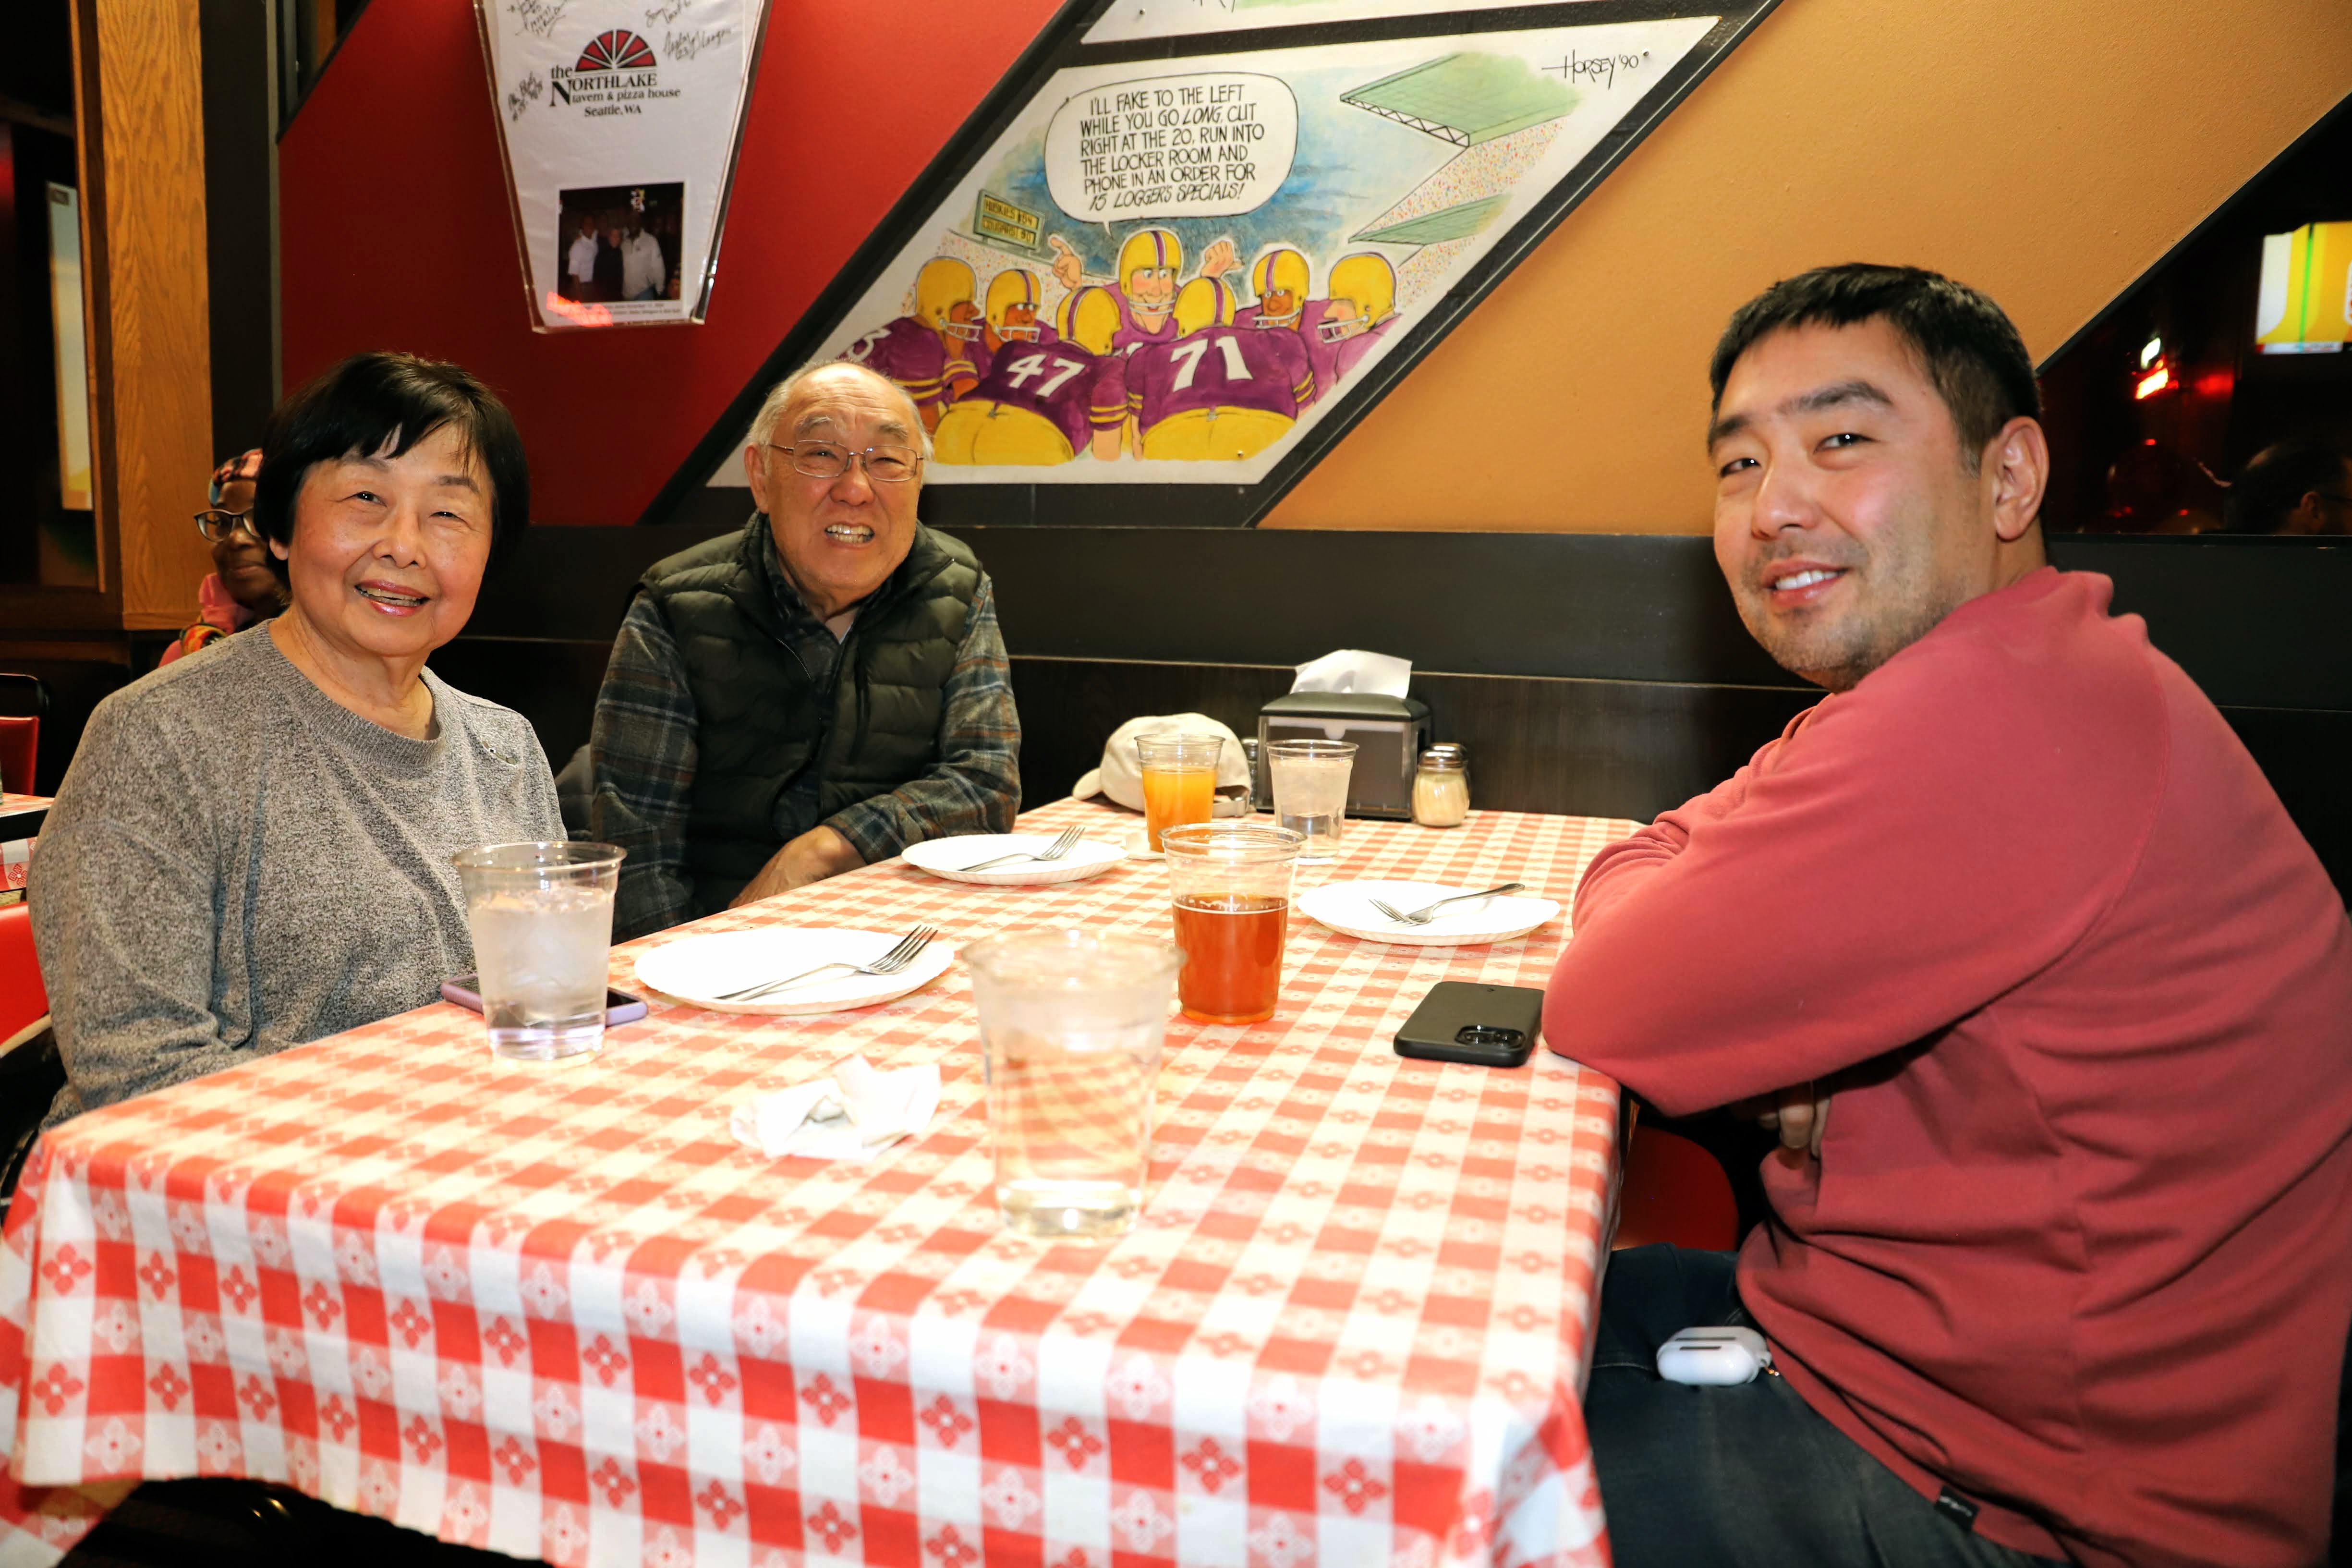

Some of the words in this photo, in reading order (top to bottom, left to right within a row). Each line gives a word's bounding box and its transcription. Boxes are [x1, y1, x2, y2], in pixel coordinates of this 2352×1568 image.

[550, 65, 572, 79] the
[1541, 49, 1617, 90] HORSEY
[549, 73, 657, 107] NORTHLAKE
[572, 91, 604, 103] tavern
[606, 91, 614, 101] &
[617, 89, 644, 102] pizza
[648, 88, 681, 98] house
[1090, 97, 1111, 115] I'LL
[1117, 91, 1150, 112] FAKE
[1154, 89, 1173, 107] TO
[1178, 86, 1203, 105] THE
[1211, 84, 1245, 103] LEFT
[624, 104, 642, 114] WA
[1080, 115, 1120, 137] WHILE
[1126, 111, 1152, 130] YOU
[1159, 109, 1179, 127] GO
[1228, 103, 1257, 122] CUT
[1081, 135, 1118, 157] RIGHT
[1122, 133, 1137, 152] AT
[1142, 129, 1166, 149] THE
[1200, 126, 1227, 144] RUN
[1233, 123, 1264, 143] INTO
[1081, 157, 1106, 176] THE
[1112, 151, 1164, 172] LOCKER
[1169, 146, 1212, 166] ROOM
[1219, 145, 1249, 162] AND
[1084, 173, 1128, 195] PHONE
[1132, 171, 1144, 187] IN
[1148, 169, 1165, 184] AN
[1171, 165, 1220, 182] ORDER
[1226, 162, 1256, 181] FOR
[1089, 193, 1107, 211] 15
[1177, 182, 1245, 202] SPECIALS!
[1007, 354, 1085, 398] 47
[1170, 335, 1254, 392] 71
